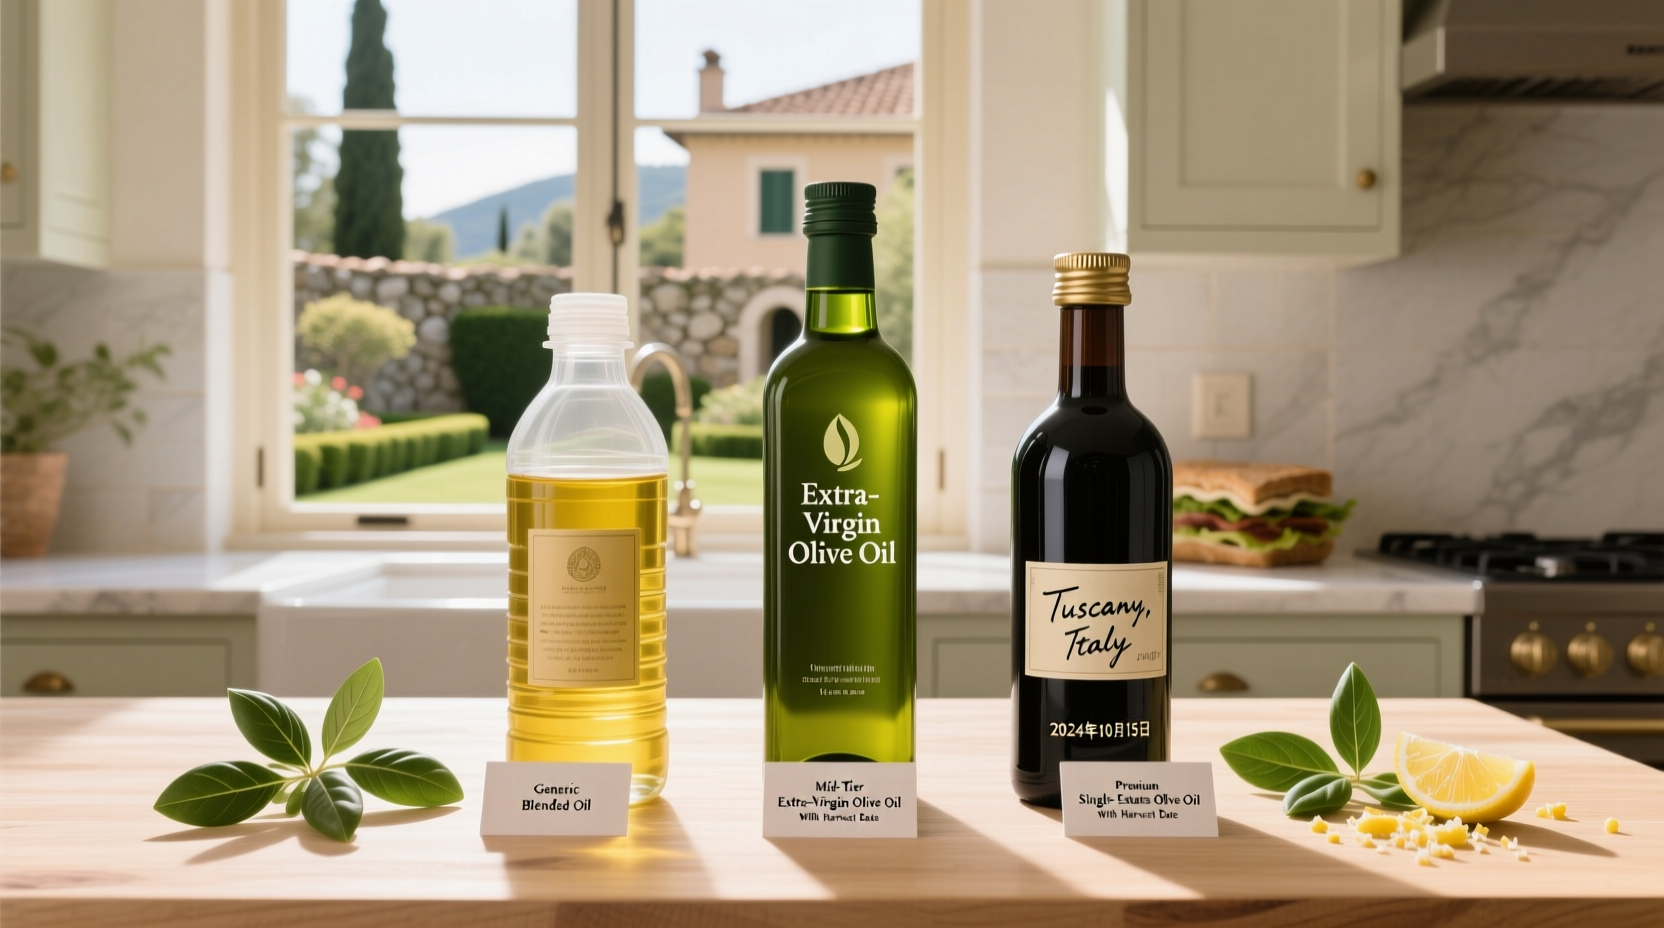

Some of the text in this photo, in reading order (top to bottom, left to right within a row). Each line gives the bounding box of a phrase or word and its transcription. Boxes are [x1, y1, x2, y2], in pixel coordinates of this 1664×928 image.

[801, 482, 879, 506] Extra-
[803, 511, 881, 541] Virgin
[788, 540, 896, 564] Olive Oil
[1042, 586, 1151, 628] Tuscany,
[1050, 721, 1150, 740] 2024年10月15日
[534, 783, 580, 794] Generic
[522, 799, 592, 811] Blended Oil
[852, 796, 881, 808] Olive
[884, 796, 901, 808] Oil
[1154, 794, 1181, 805] Olive
[1183, 794, 1200, 805] Oil
